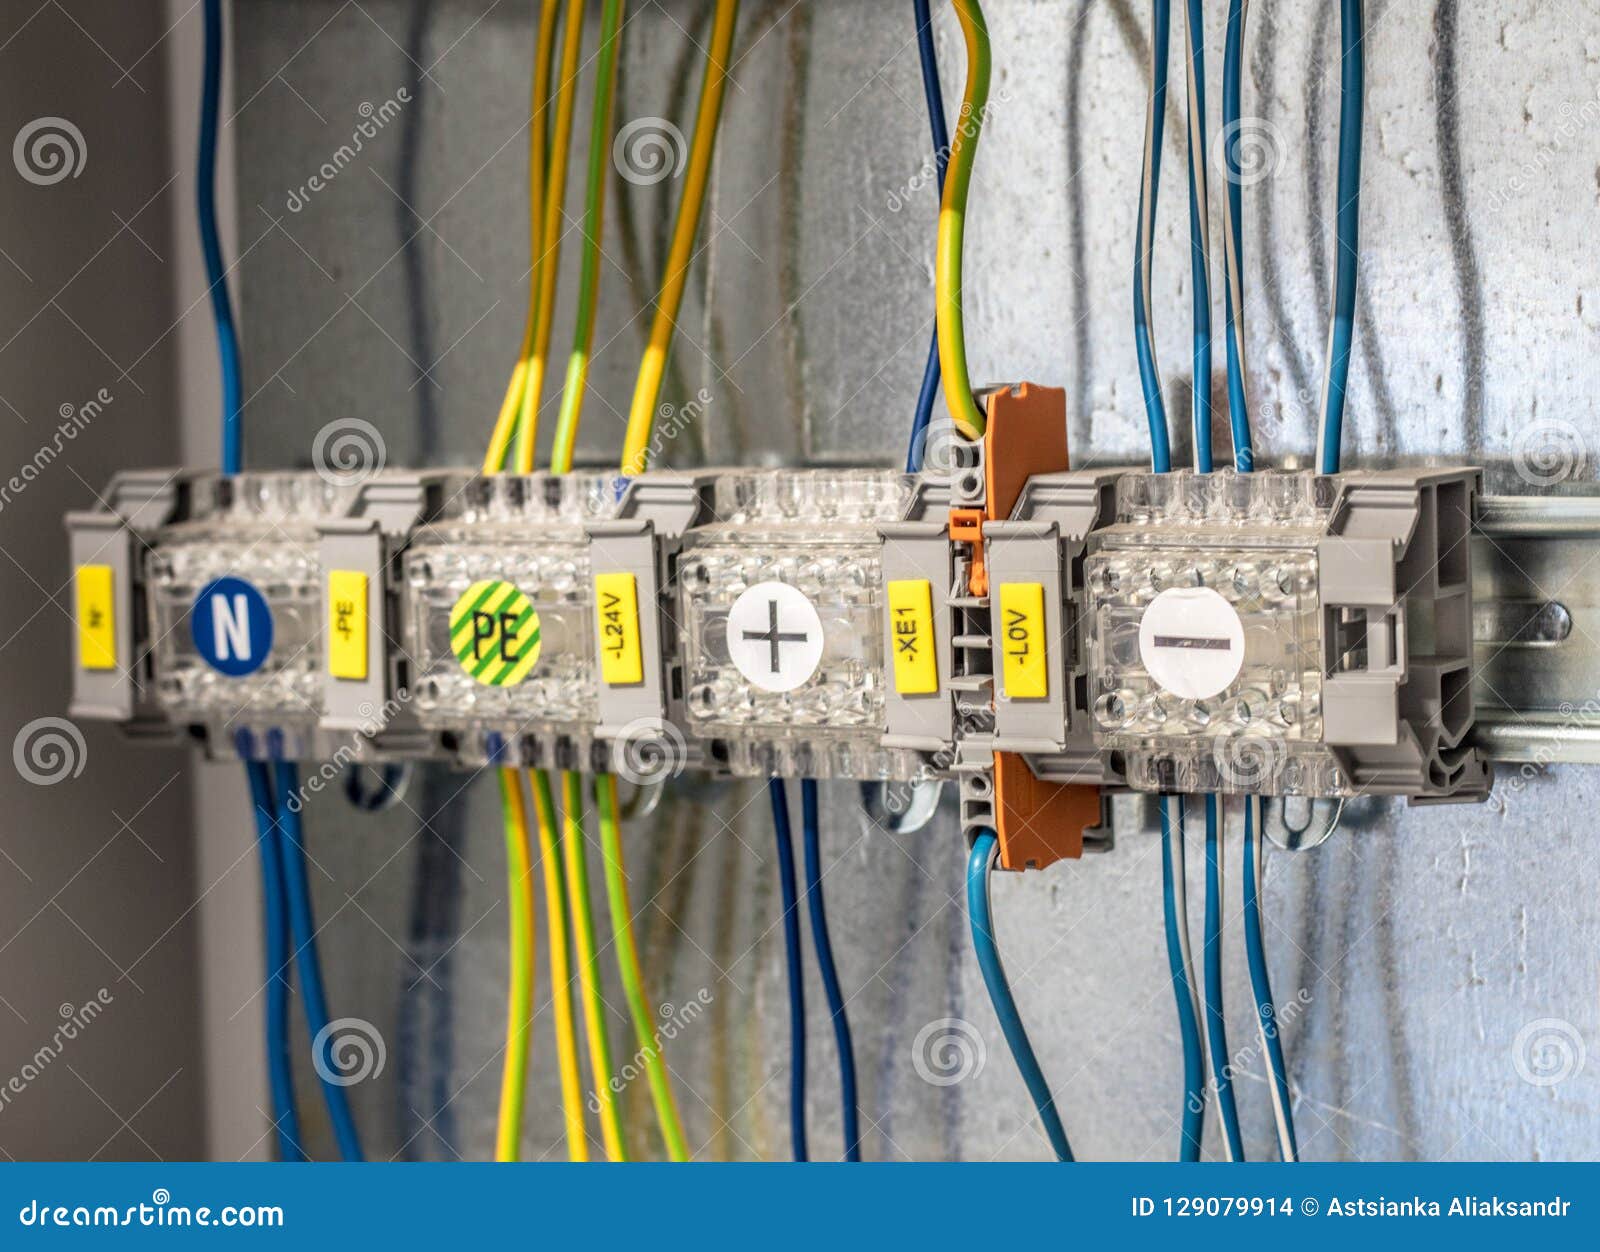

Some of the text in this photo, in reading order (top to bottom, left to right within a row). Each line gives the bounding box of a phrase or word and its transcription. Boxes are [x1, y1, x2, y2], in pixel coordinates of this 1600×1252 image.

[211, 594, 251, 661] N
[473, 611, 520, 662] PE
[603, 592, 624, 660] -L24V
[895, 607, 918, 662] -XE1
